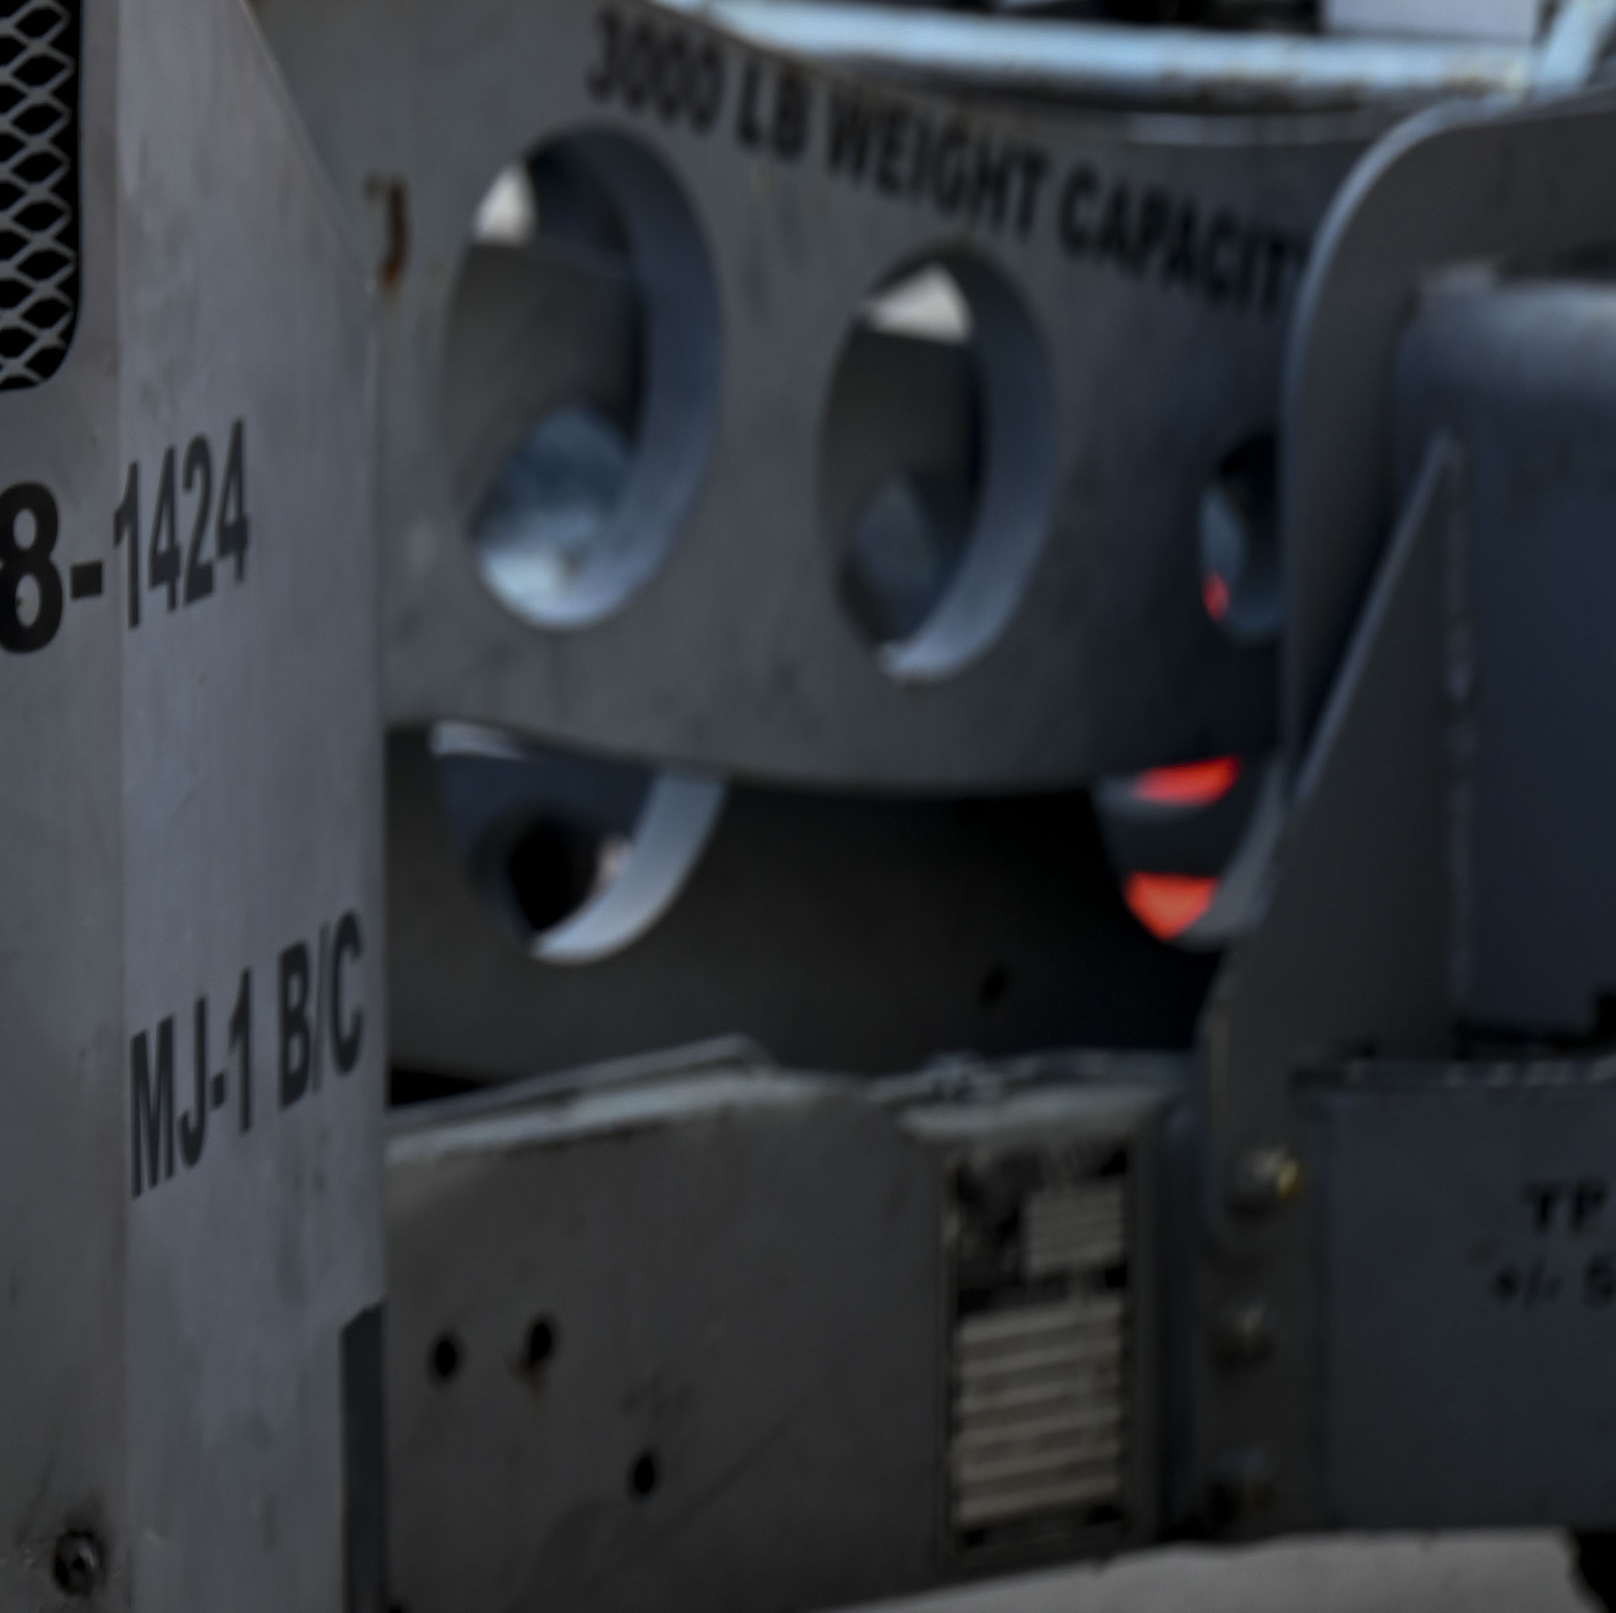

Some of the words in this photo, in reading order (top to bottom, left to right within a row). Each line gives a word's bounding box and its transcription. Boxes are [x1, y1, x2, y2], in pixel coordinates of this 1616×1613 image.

[584, 3, 724, 139] 3000
[736, 52, 812, 167] LB
[830, 93, 1049, 240] WEIGHT
[131, 965, 252, 1200] MJ-1
[278, 908, 365, 1112] B/C
[1521, 1178, 1608, 1237] TP
